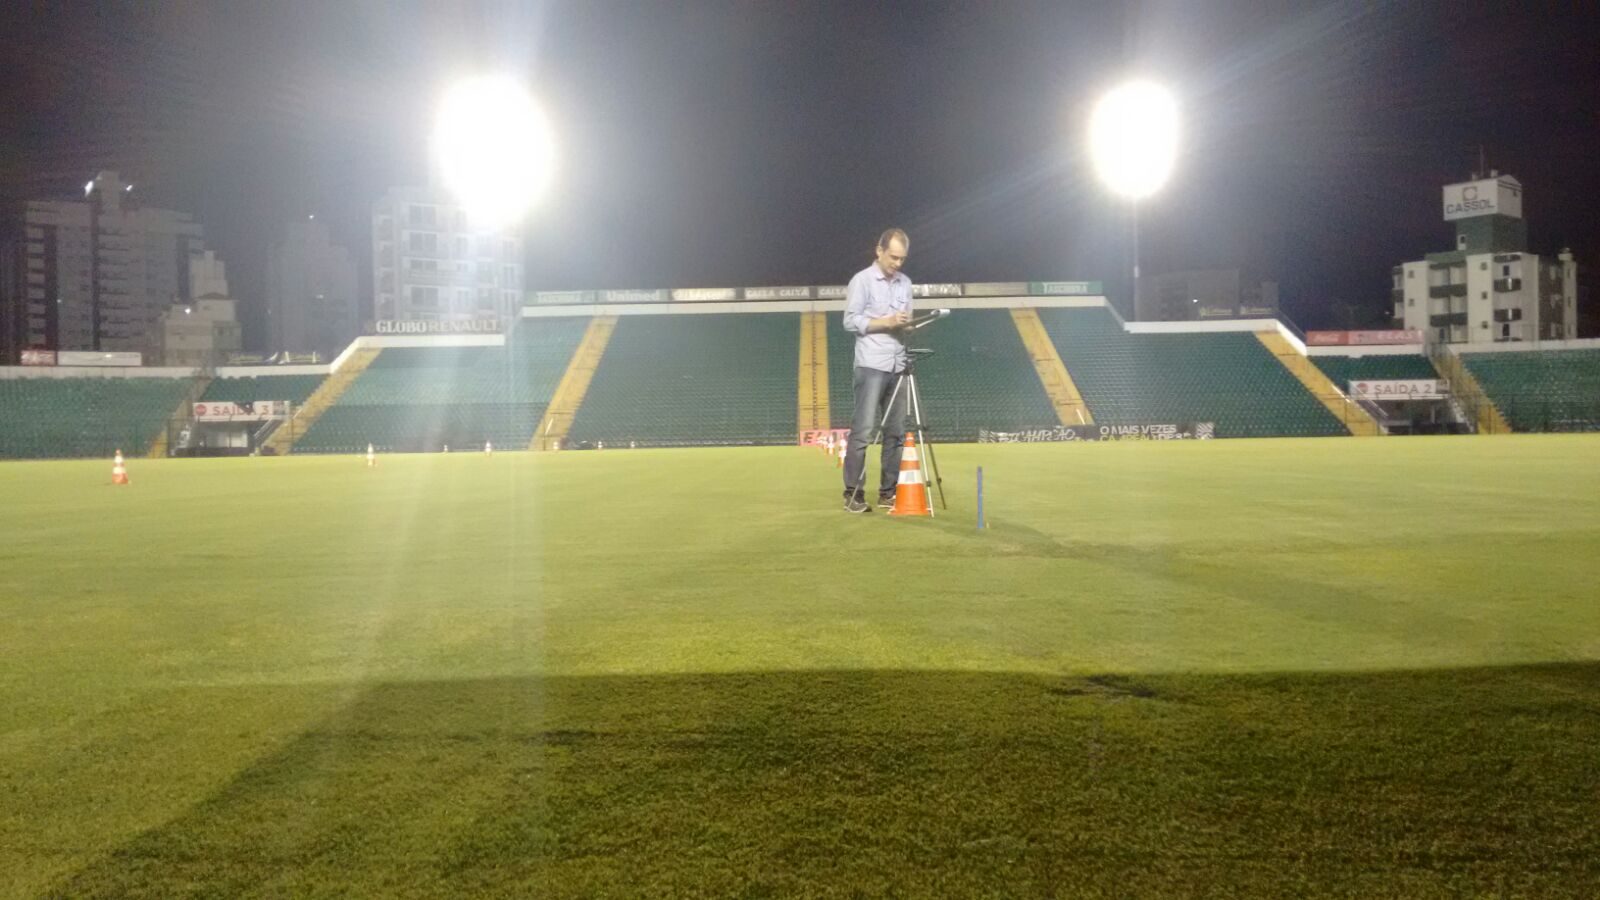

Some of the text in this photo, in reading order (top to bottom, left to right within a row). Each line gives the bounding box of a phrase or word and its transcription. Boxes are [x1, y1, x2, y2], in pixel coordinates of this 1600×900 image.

[1446, 199, 1497, 214] CASSOL
[780, 287, 809, 297] CAIXA
[375, 319, 500, 333] GLOBO RENAULT
[1424, 383, 1432, 394] 2
[261, 405, 269, 415] 3
[1099, 424, 1177, 435] O MAIS VEZES
